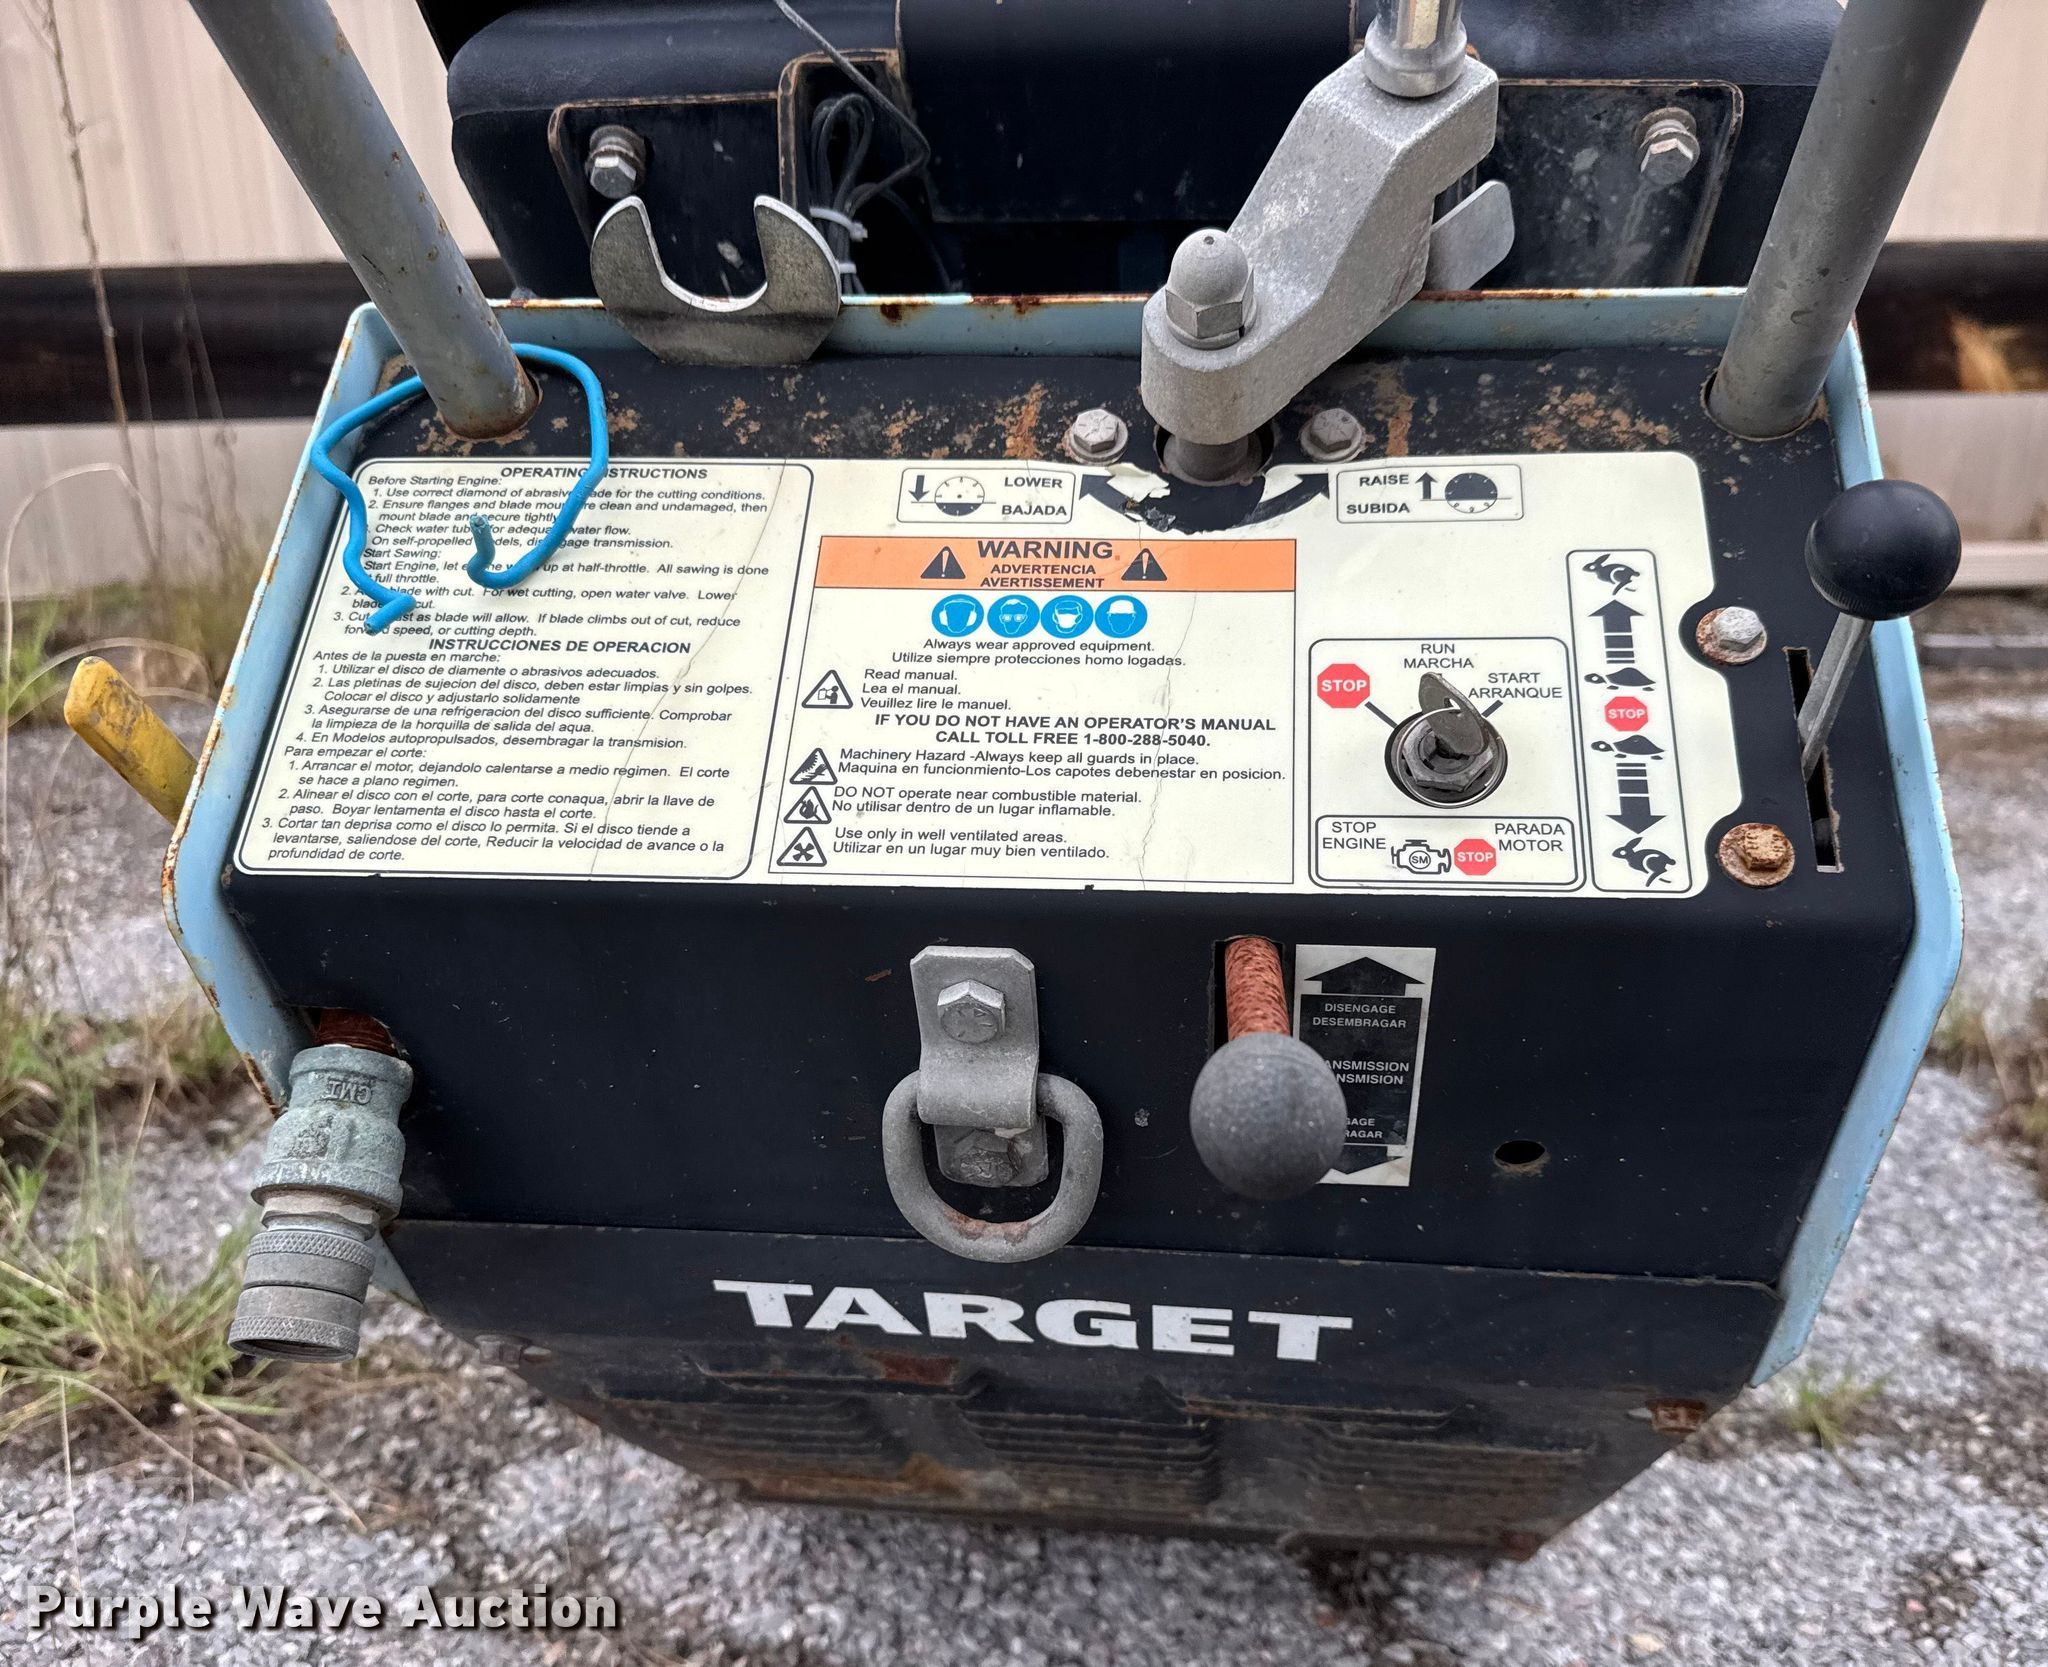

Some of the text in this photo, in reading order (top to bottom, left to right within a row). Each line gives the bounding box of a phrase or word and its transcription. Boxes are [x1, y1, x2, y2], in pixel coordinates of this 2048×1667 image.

[368, 475, 502, 488] Before Starting Engine:
[1004, 476, 1063, 489] LOWER
[1359, 473, 1409, 487] RAISE
[373, 488, 382, 497] 1.
[386, 487, 410, 497] Use
[412, 488, 454, 498] correct
[455, 487, 508, 498] diamond
[510, 488, 524, 498] of
[615, 488, 633, 499] for
[635, 488, 654, 499] the
[657, 489, 698, 502] cutting
[700, 490, 765, 500] conditions.
[1001, 504, 1067, 517] BAJADA
[1346, 502, 1410, 515] SUBIDA
[977, 540, 1113, 559] WARNING
[990, 564, 1096, 575] ADVERTENCIA
[980, 577, 1105, 588] AVERTISSEMENT
[428, 638, 692, 654] INSTRUCCIONES DE OPERACION
[922, 638, 1155, 654] Always wear approved equipment.
[1420, 643, 1455, 655] RUN
[312, 650, 501, 663] Antes de la puesta en marche:
[892, 652, 1186, 668] Utilize siempre protecciones homo logadas.
[1403, 657, 1474, 669] MARCHA
[319, 664, 660, 679] 1. Utilizar el disco de diamente o abrasivos adecuados.
[864, 668, 958, 681] Read manual.
[1487, 672, 1540, 685] START
[862, 682, 961, 695] Lea el manual.
[1321, 679, 1367, 693] STOP
[1468, 687, 1563, 699] ARRANQUE
[860, 696, 1011, 710] Veuillez lire le manuel.
[1607, 708, 1645, 719] STOP
[874, 713, 1276, 731] IF YOU DO NOT HAVE AN OPERATOR'S MANUAL
[935, 730, 1211, 747] CALL TOLL FREE 1-800-288-5040.
[284, 745, 427, 759] Para empezar el corte:
[840, 748, 1199, 767] Machinery Hazard -Always keep all guards in place.
[838, 761, 1286, 782] Maquina en funcionmiento-Los capotes debenestar en posicion.
[298, 774, 458, 790] se hace a plano regimen.
[834, 786, 1142, 803] DO NOT operate near combustible material.
[288, 803, 596, 819] paso. Boyar lentamenta el disco hasta el corte.
[832, 799, 1115, 818] No utilisar dentro de un lugar inflamable.
[1331, 821, 1377, 833] STOP
[1494, 823, 1565, 835] PARADA
[835, 826, 1067, 843] Use only in well ventilated areas.
[833, 841, 1110, 859] Utilizar en un lugar muy bien ventilado.
[1322, 837, 1387, 850] ENGINE
[1499, 839, 1563, 851] MOTOR
[267, 847, 405, 861] profundidad de corte.
[1411, 855, 1428, 864] SM
[1457, 851, 1494, 863] STOP
[1324, 1003, 1397, 1014] DISENGAGE
[1312, 1017, 1407, 1029] DESEMBRAGAR
[712, 1279, 1354, 1362] TARGET
